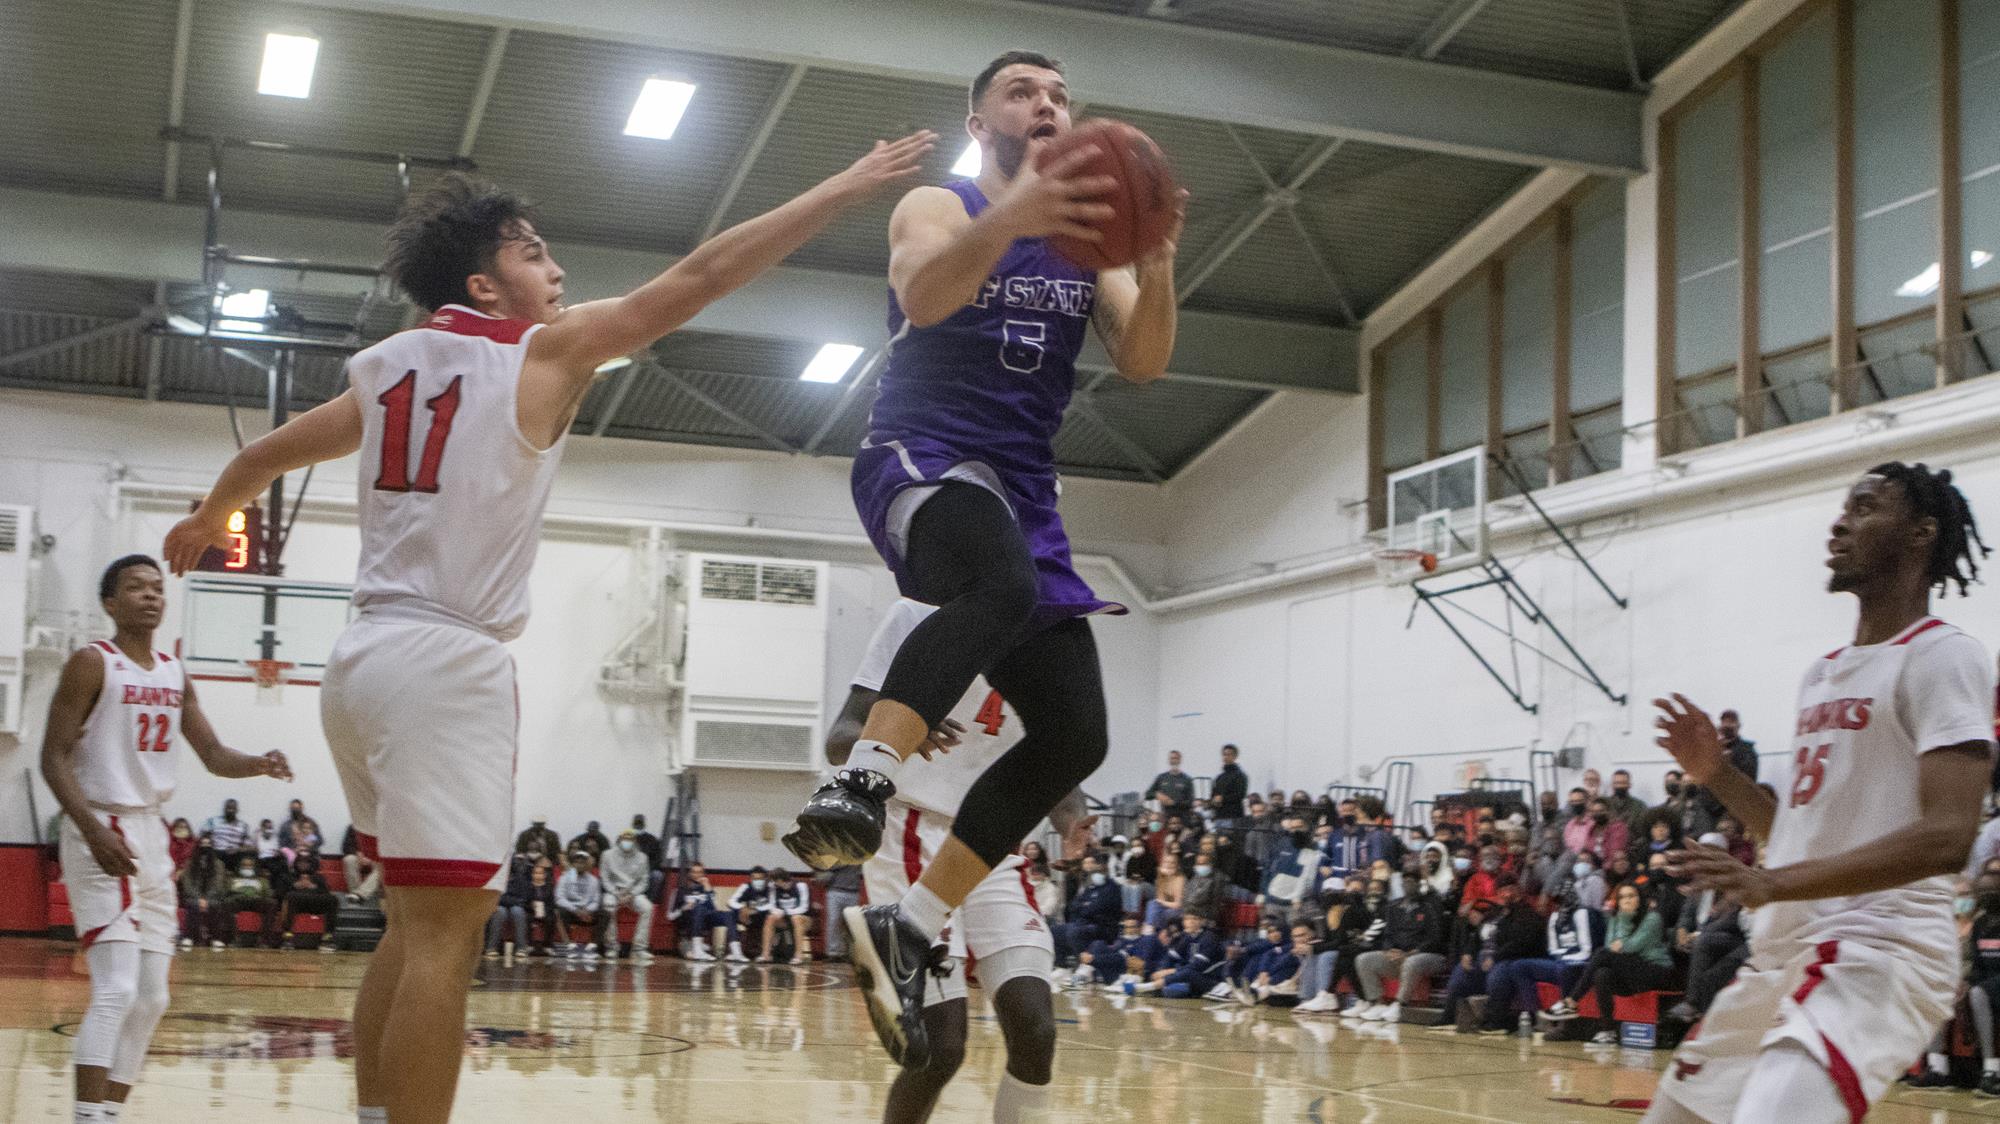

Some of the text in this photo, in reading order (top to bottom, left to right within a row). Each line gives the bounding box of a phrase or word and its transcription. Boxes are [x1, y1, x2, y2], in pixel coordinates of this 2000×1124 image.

[974, 275, 1095, 318] F STATE
[999, 319, 1045, 374] 5
[374, 369, 462, 493] 11
[137, 712, 171, 752] 22
[974, 688, 1006, 736] 4
